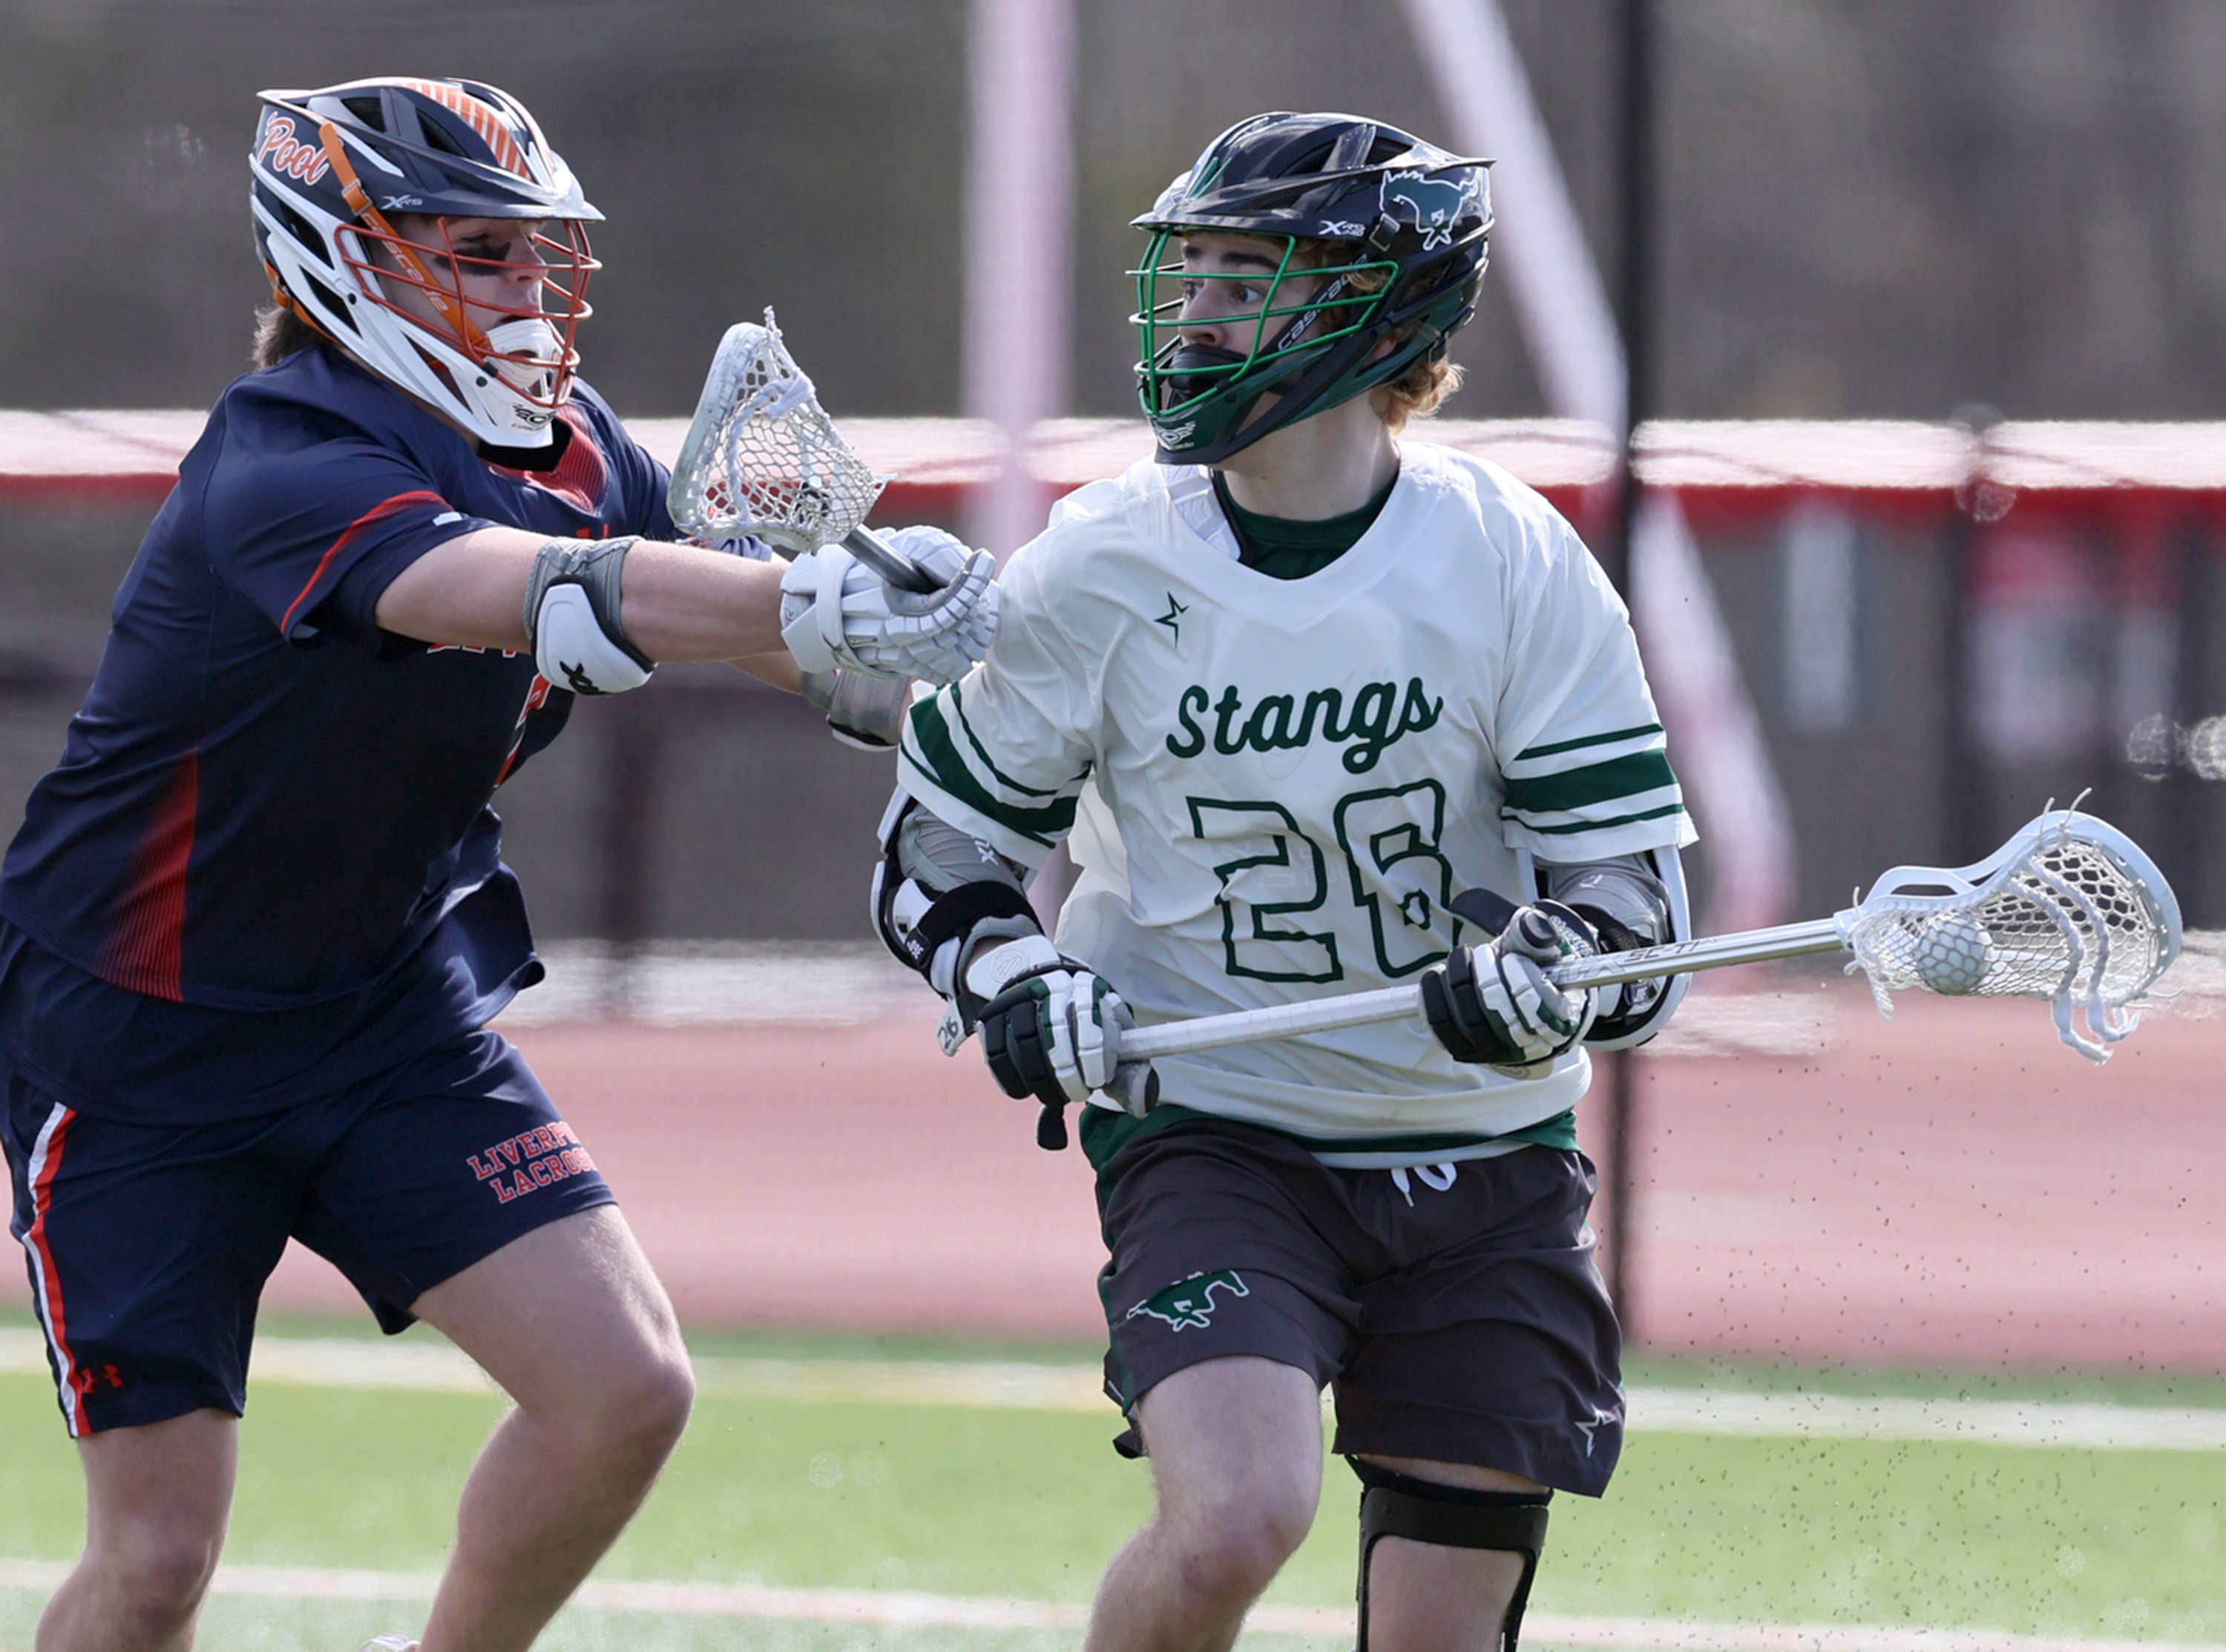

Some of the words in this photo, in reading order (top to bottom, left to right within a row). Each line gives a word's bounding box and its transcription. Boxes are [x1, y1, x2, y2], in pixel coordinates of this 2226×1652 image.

[1166, 677, 1443, 774] Stangs
[1186, 778, 1463, 983] 26
[937, 1016, 959, 1050] 26
[490, 1148, 599, 1205] LACROS
